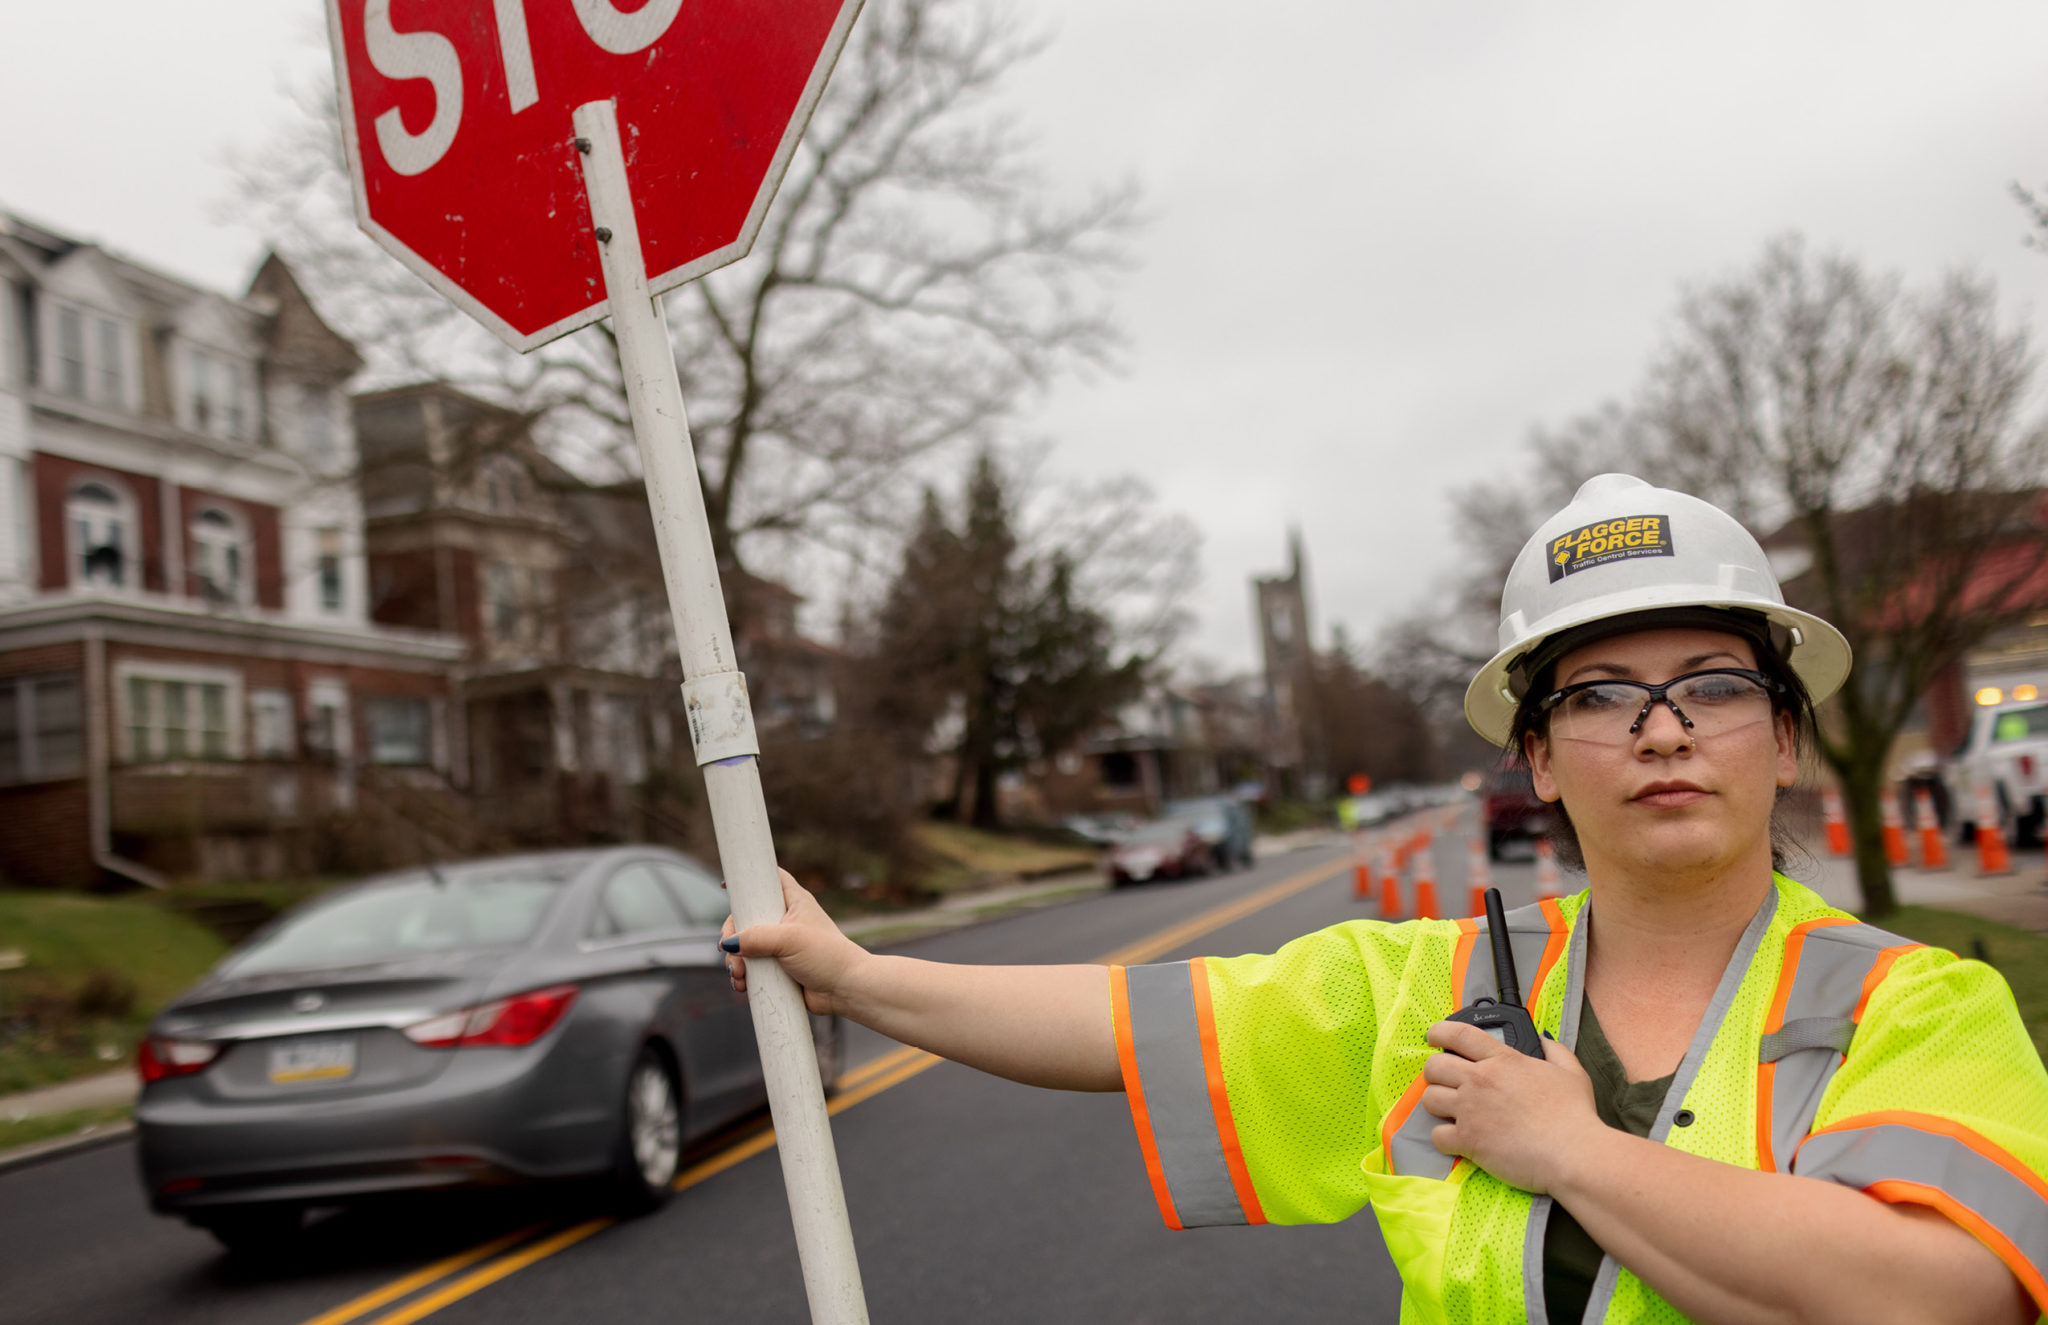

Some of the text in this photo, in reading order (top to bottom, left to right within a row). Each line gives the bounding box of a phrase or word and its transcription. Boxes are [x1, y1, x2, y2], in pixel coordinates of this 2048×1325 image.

[363, 0, 683, 176] ST
[1552, 517, 1660, 555] FLAGGER
[1576, 530, 1660, 559] FORCE
[1572, 548, 1663, 570] Traffic Control Services
